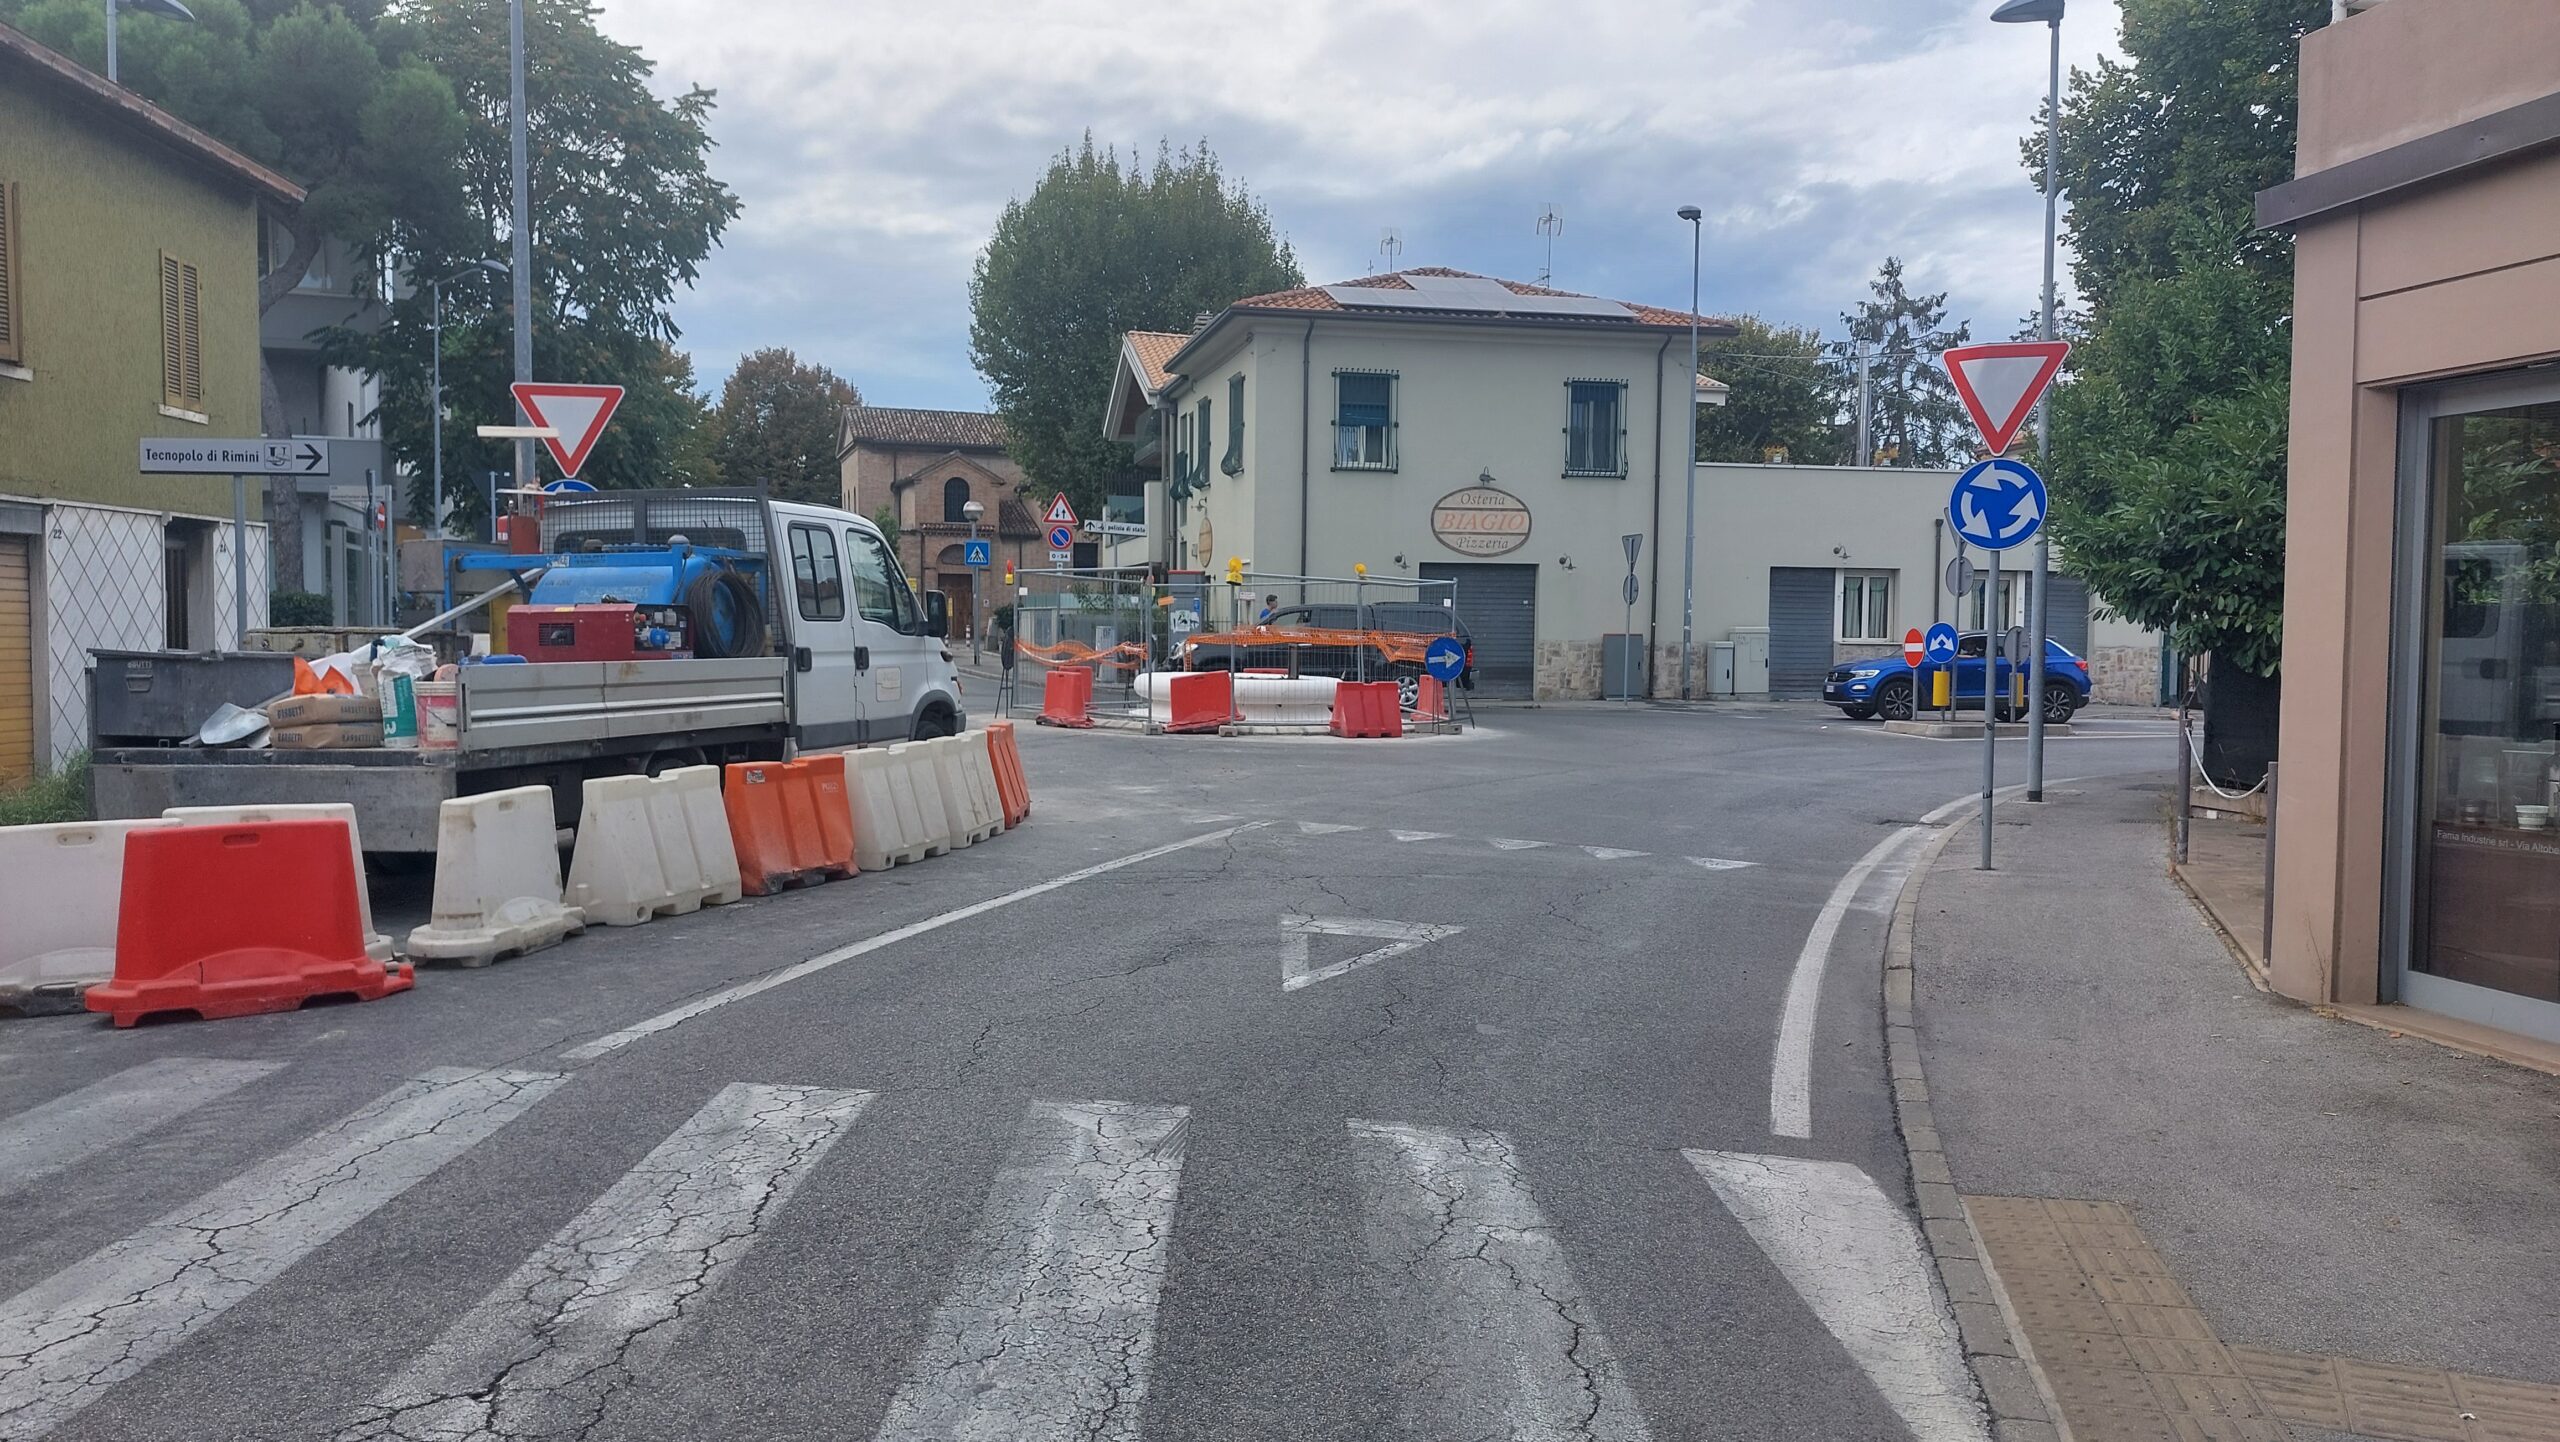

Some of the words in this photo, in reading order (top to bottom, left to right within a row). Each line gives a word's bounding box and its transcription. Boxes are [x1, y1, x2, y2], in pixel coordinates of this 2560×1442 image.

[146, 448, 203, 464] Tecnopolo
[207, 450, 218, 462] di
[222, 450, 259, 463] Rimini
[1460, 492, 1505, 505] Osteria
[1439, 512, 1525, 531] BIAGIO
[53, 528, 62, 539] 22
[1456, 536, 1509, 549] Pizzeria
[2437, 829, 2459, 841] Fama
[2516, 841, 2530, 851] Via
